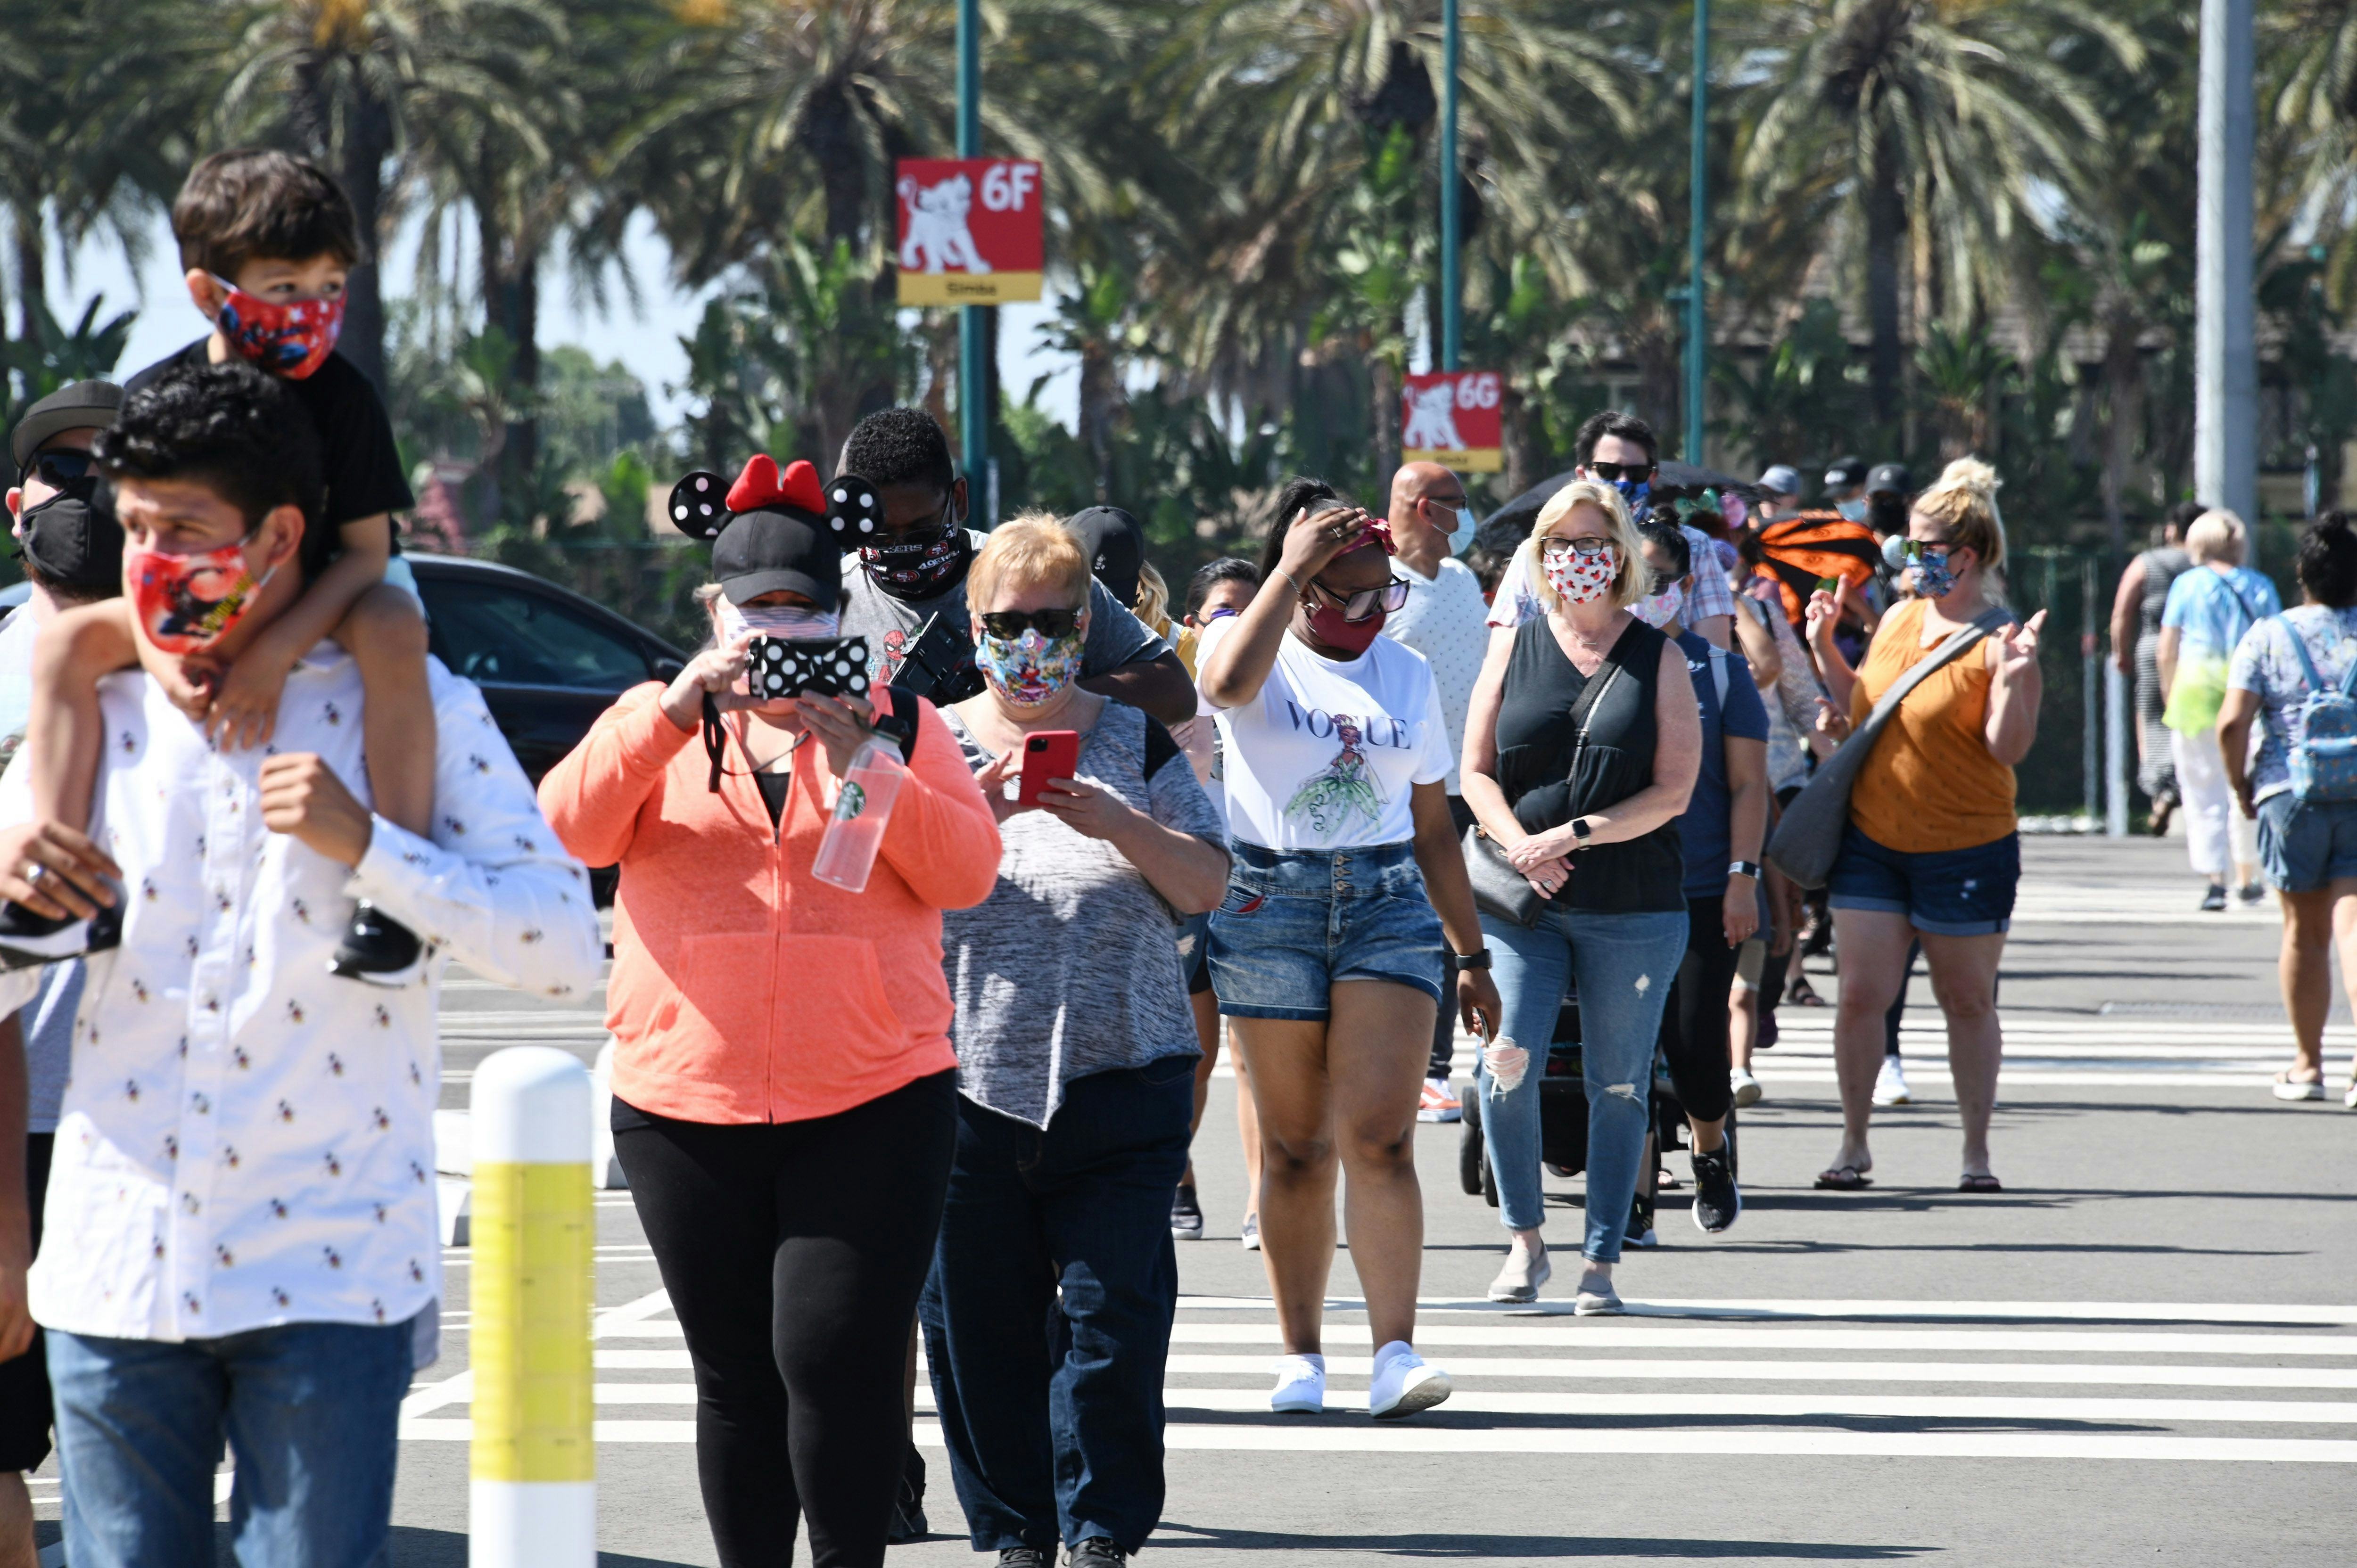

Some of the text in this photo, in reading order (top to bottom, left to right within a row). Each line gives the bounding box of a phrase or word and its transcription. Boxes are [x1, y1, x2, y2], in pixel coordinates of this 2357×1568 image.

[981, 163, 1038, 212] 6F
[1456, 373, 1500, 410] 6G
[1284, 699, 1411, 749] VOUE
